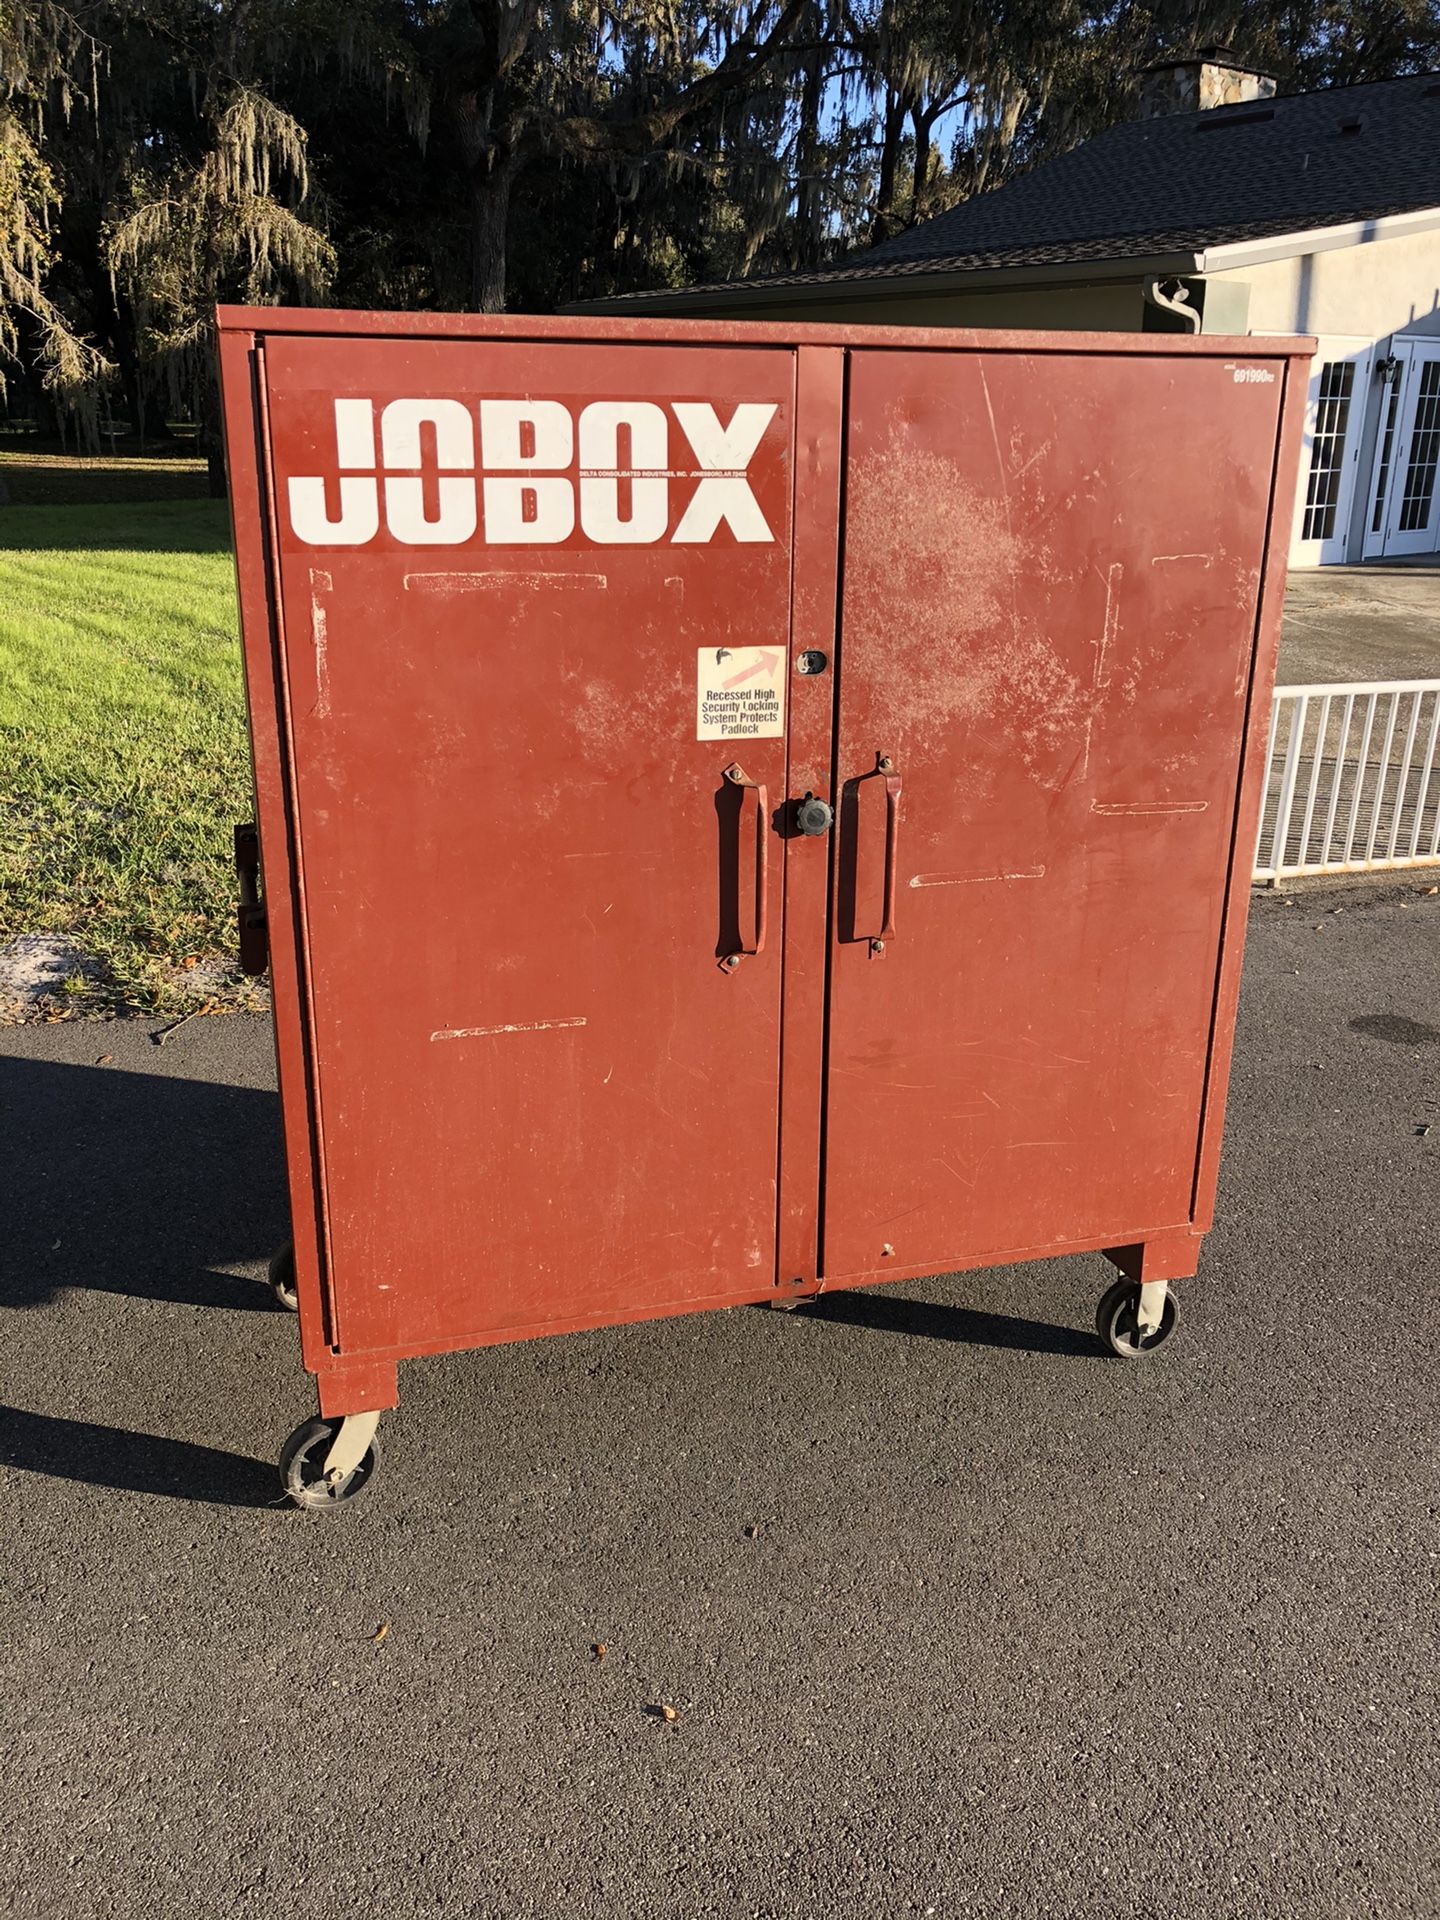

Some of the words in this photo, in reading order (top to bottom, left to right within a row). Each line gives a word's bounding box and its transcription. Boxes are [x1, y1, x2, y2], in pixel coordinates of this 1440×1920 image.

[288, 398, 778, 545] JOBOX
[579, 470, 598, 478] DELTA
[598, 470, 642, 478] CONSOLIDATED
[706, 690, 752, 701] Recessed
[754, 689, 775, 702] High
[702, 702, 740, 713] Security
[743, 701, 779, 712] Locking
[703, 714, 737, 725] System
[740, 712, 778, 723] Protects
[721, 724, 759, 735] Padlock
